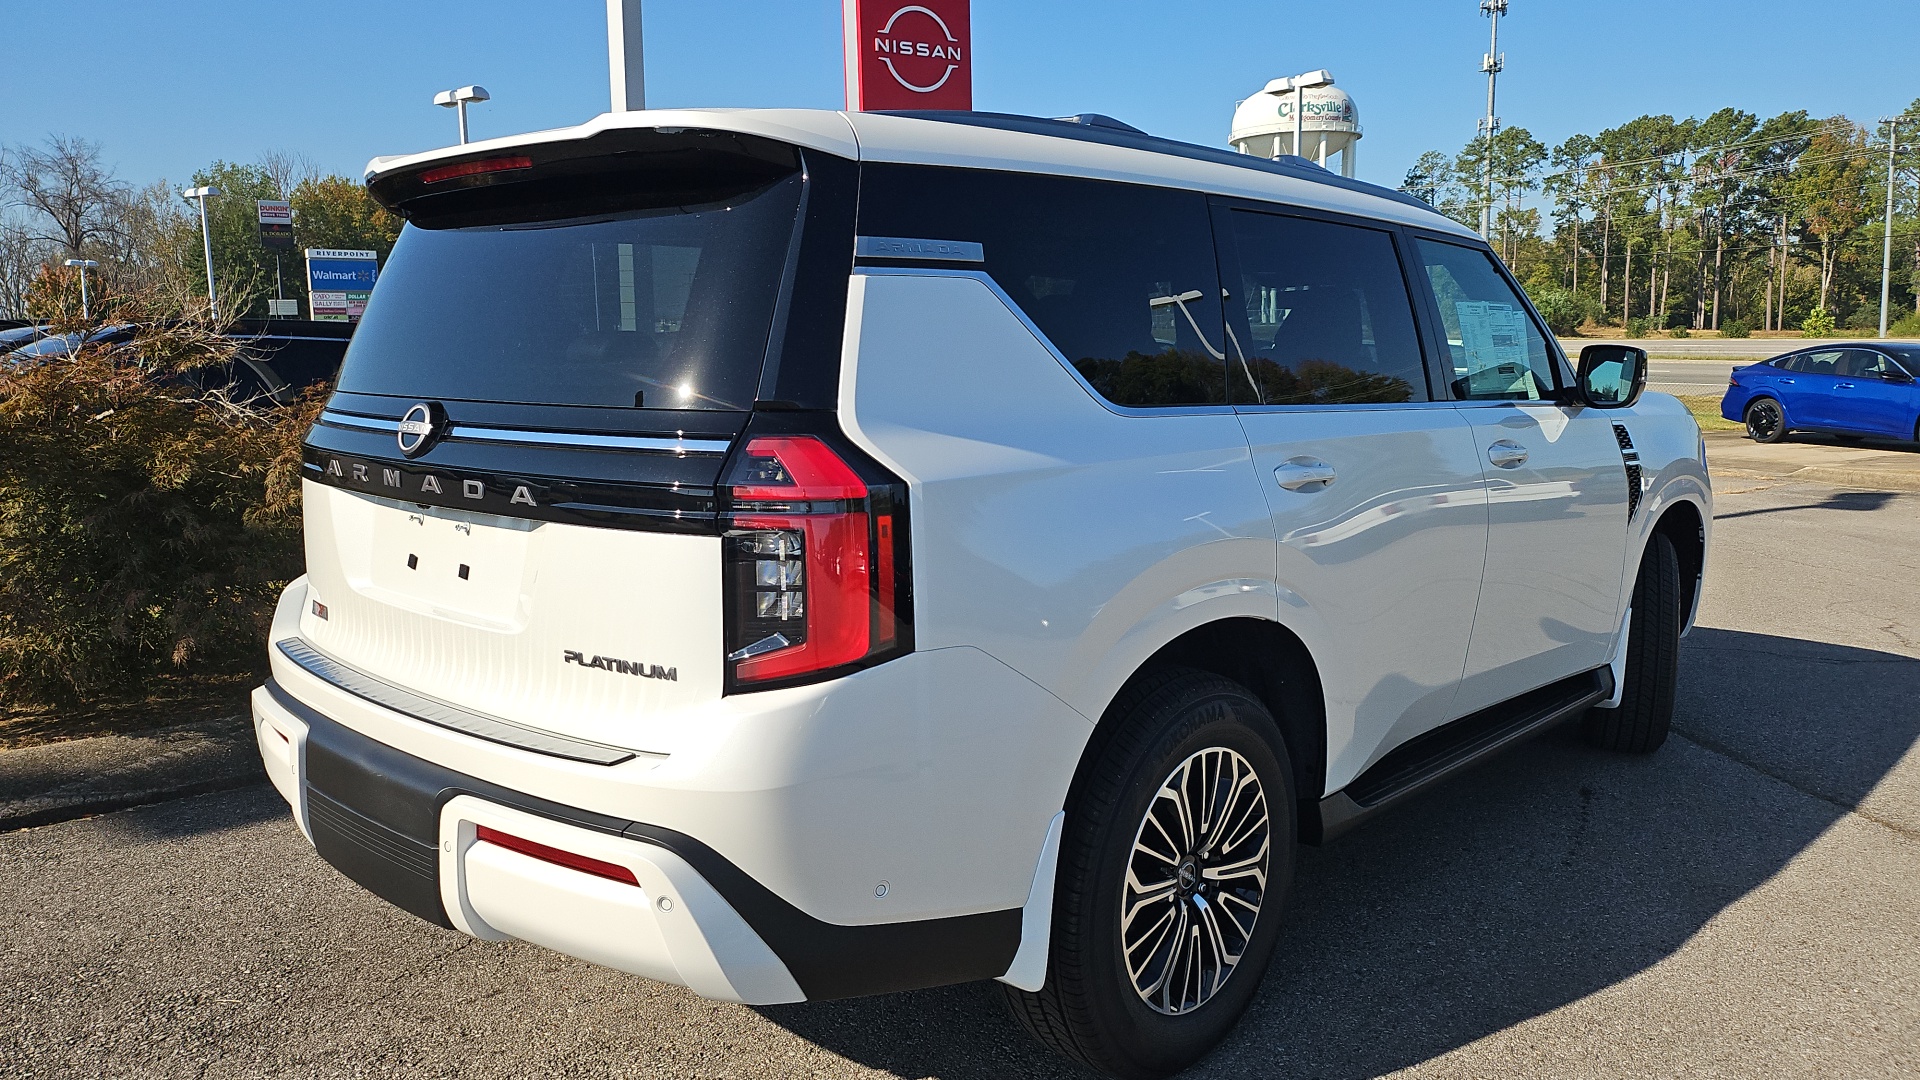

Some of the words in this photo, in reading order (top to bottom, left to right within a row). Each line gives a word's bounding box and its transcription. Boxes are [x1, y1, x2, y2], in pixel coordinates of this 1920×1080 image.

[875, 37, 961, 61] NISSAN
[1278, 101, 1342, 117] Clrksville
[312, 270, 357, 281] Walmart
[325, 459, 538, 507] ARMADA
[563, 649, 678, 682] PLATINUM
